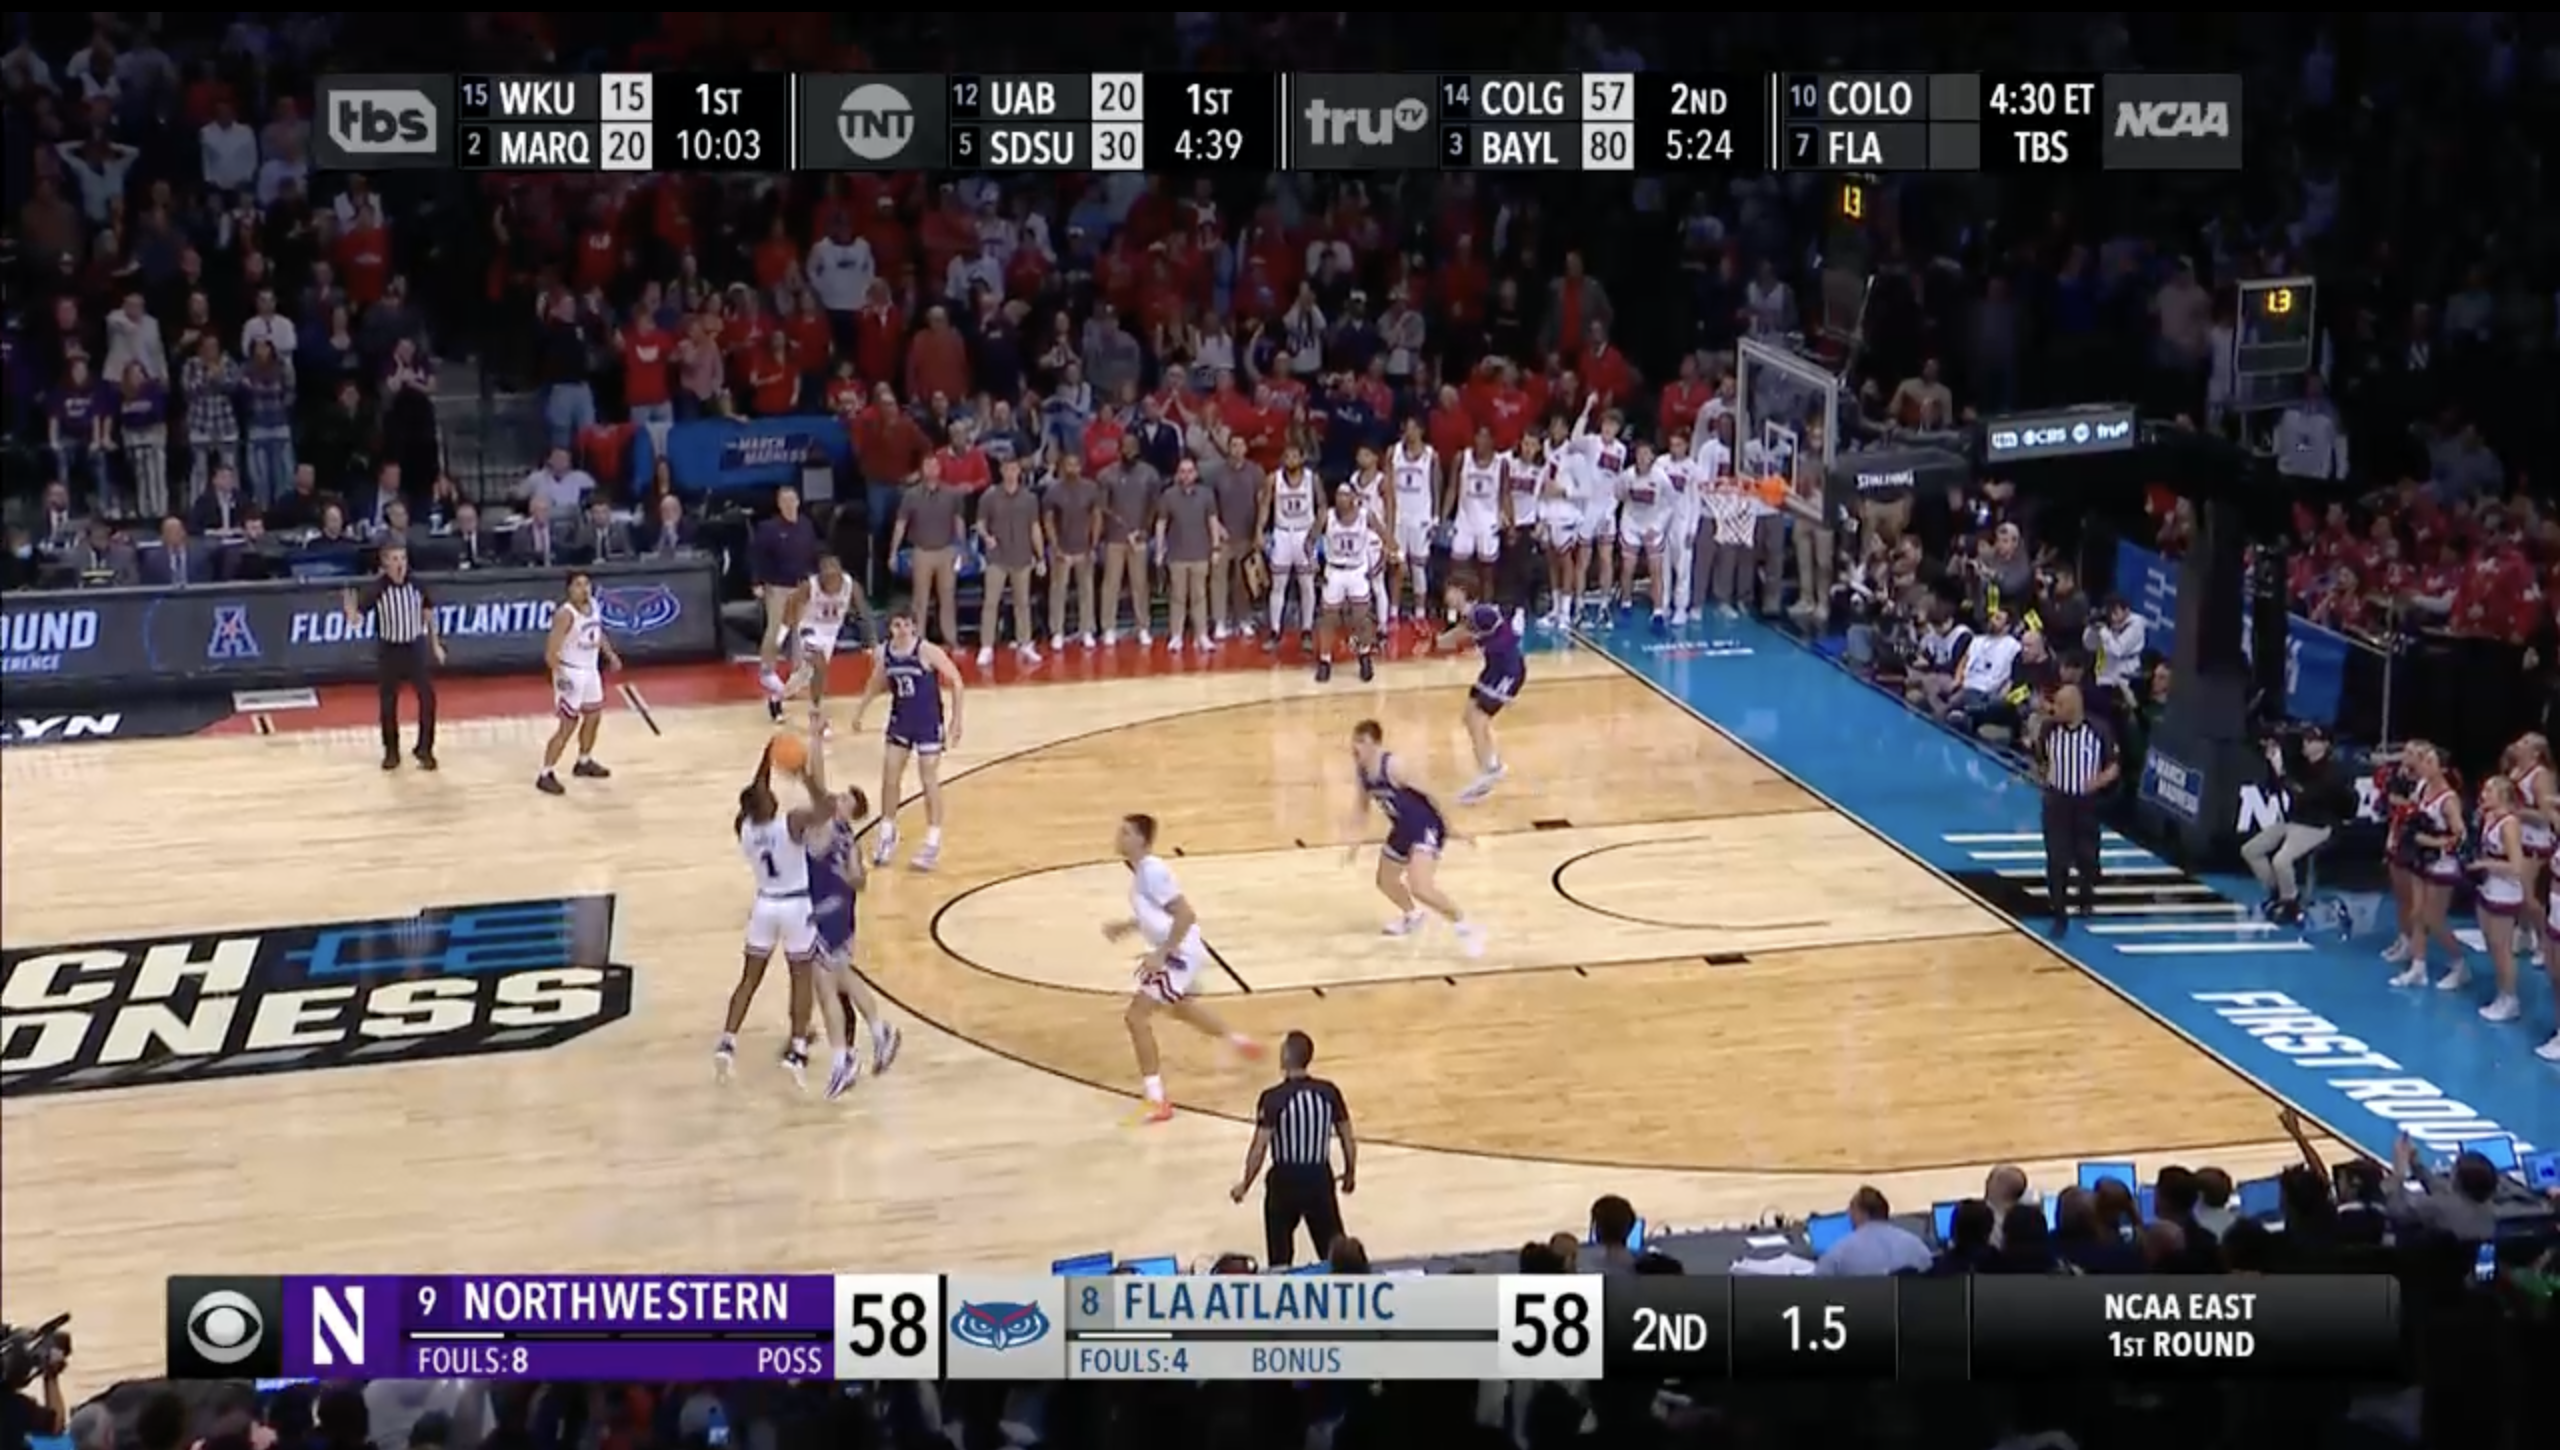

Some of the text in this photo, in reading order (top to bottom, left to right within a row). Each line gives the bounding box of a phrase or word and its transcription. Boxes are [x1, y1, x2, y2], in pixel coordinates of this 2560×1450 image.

[897, 674, 915, 697] 13
[0, 713, 122, 742] YN
[760, 851, 780, 877] 1
[0, 936, 263, 1012] CH
[2189, 990, 2404, 1071] FIRST
